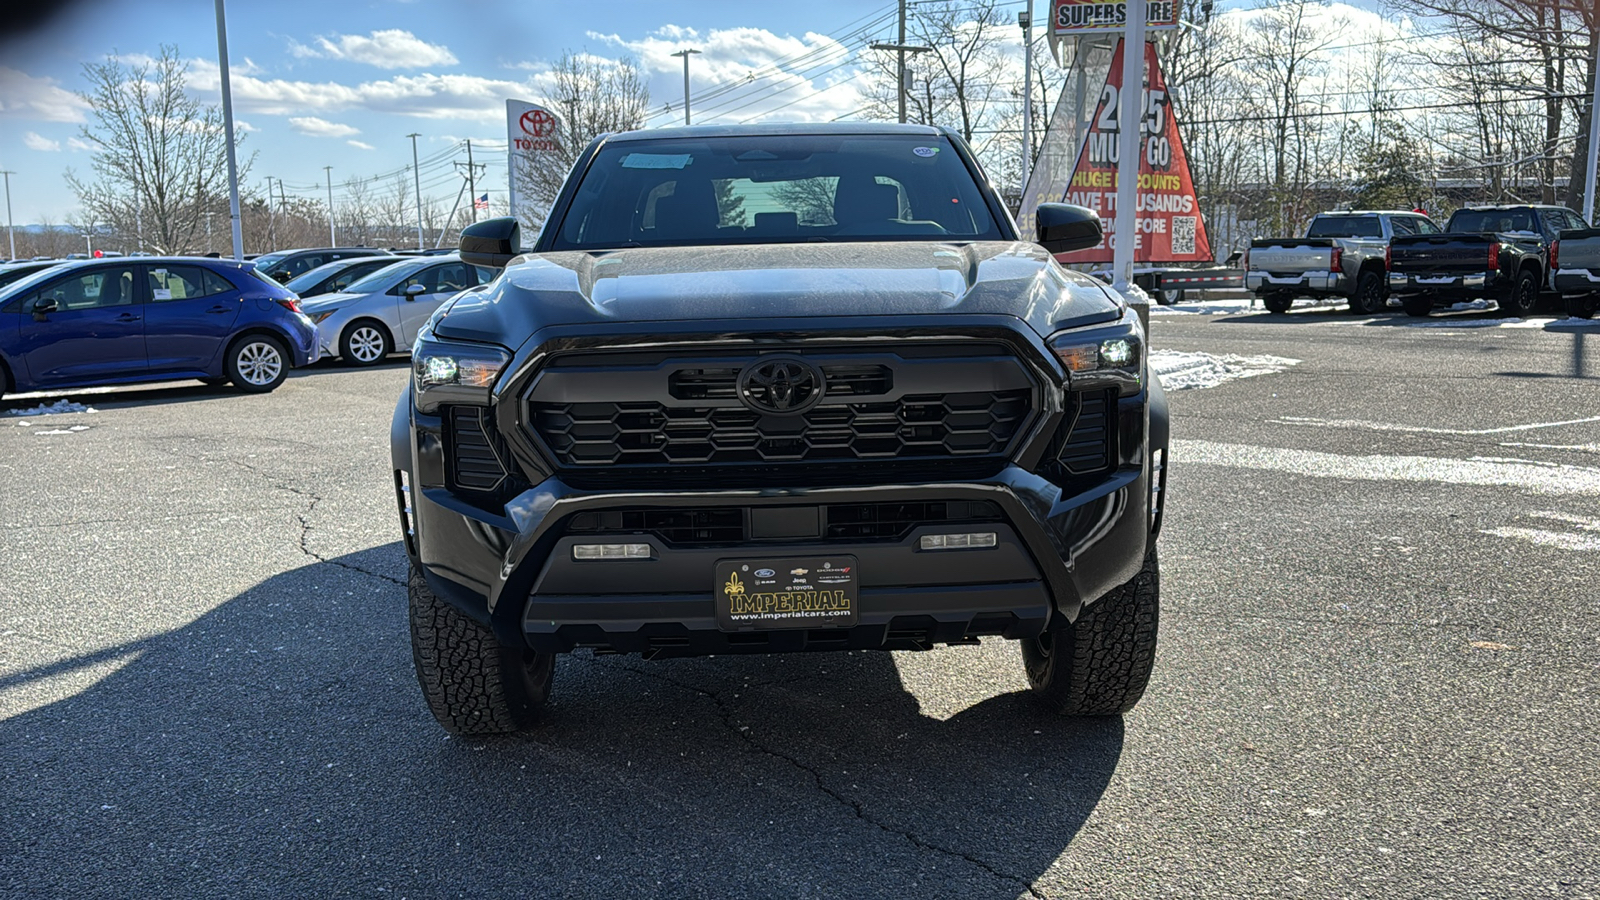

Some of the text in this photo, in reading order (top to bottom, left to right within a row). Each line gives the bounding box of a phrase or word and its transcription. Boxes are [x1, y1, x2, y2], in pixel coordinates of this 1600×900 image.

[1058, 1, 1173, 26] SUPERSRE
[1098, 84, 1165, 134] 25
[1088, 132, 1169, 167] MU GO
[1072, 171, 1181, 190] HUGE COUNTS
[1105, 192, 1194, 213] TUSANDS
[1134, 217, 1167, 234] FORE
[1108, 234, 1142, 250] GE
[730, 590, 851, 614] IMPERIAL
[730, 610, 851, 621] www.imperialcars.com
